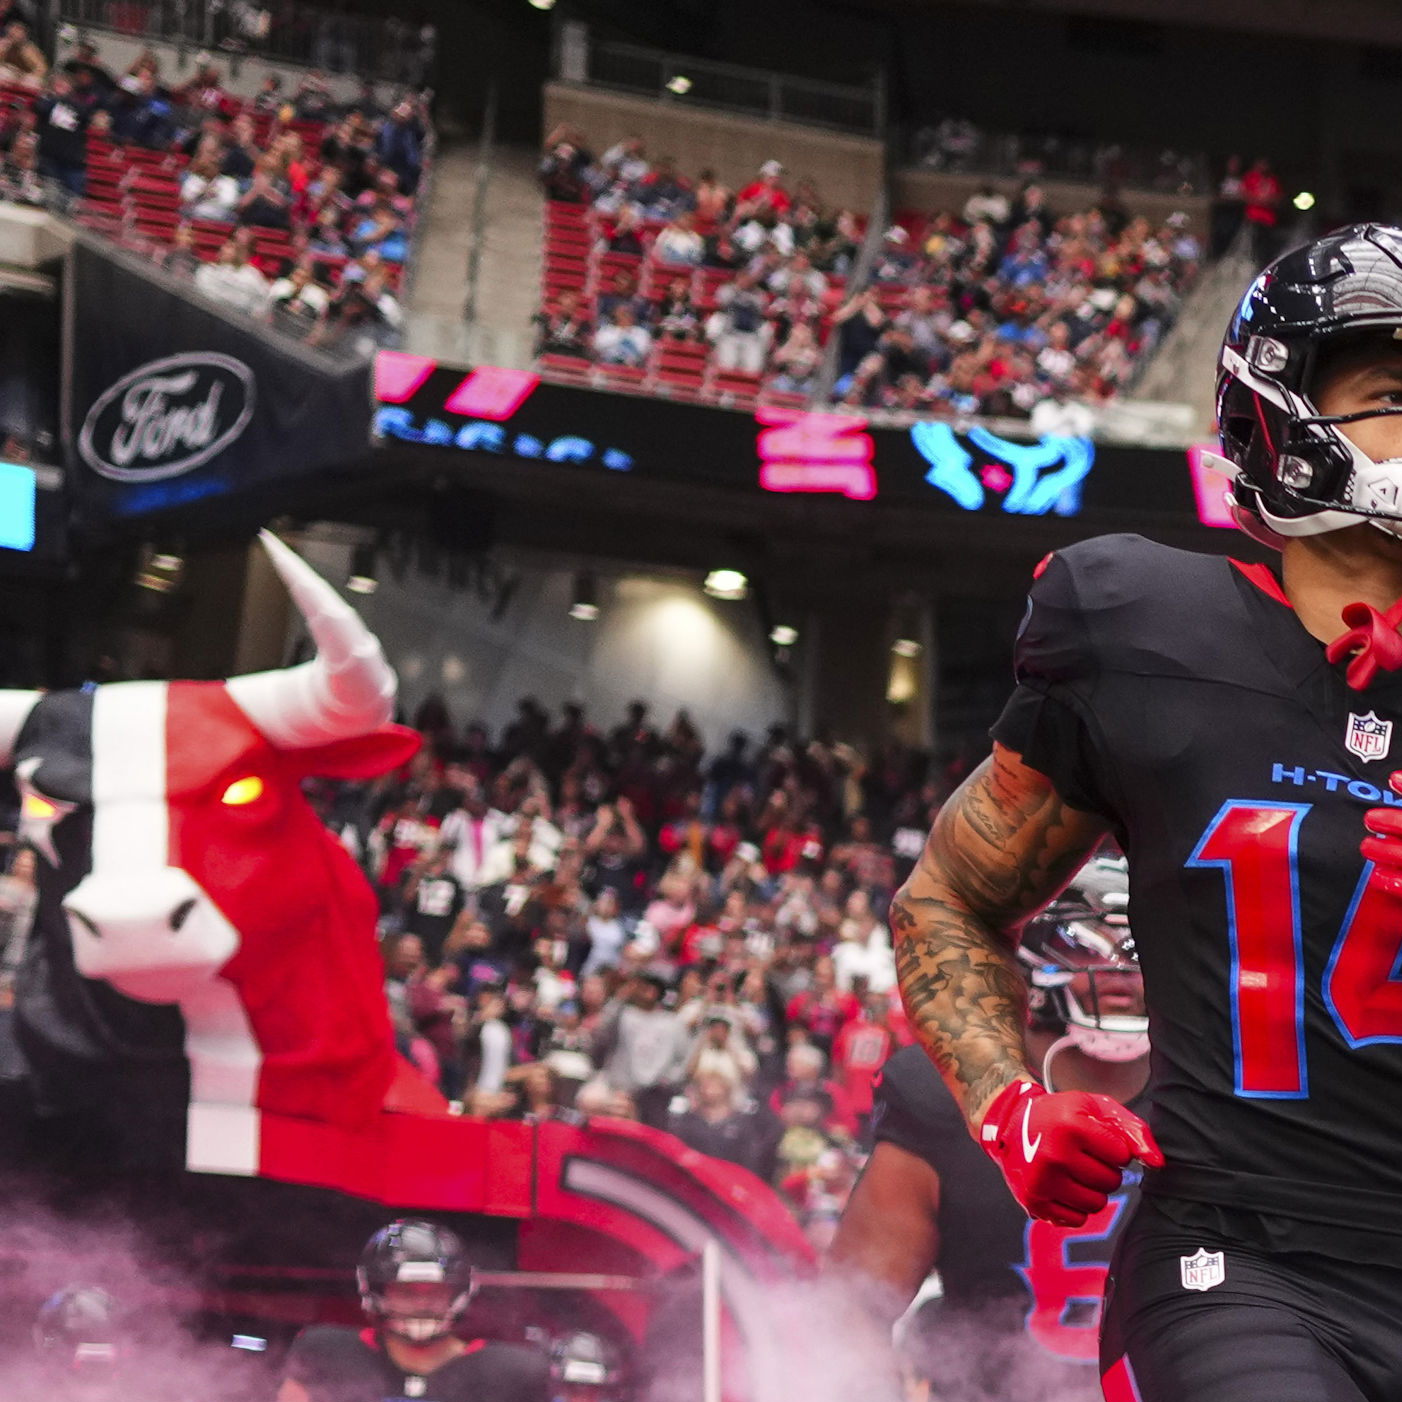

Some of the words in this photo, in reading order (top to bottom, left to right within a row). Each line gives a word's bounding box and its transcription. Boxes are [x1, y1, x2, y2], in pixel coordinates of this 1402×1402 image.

[111, 370, 224, 466] Ford
[1353, 732, 1382, 752] NFL
[1188, 1267, 1218, 1284] NFL
